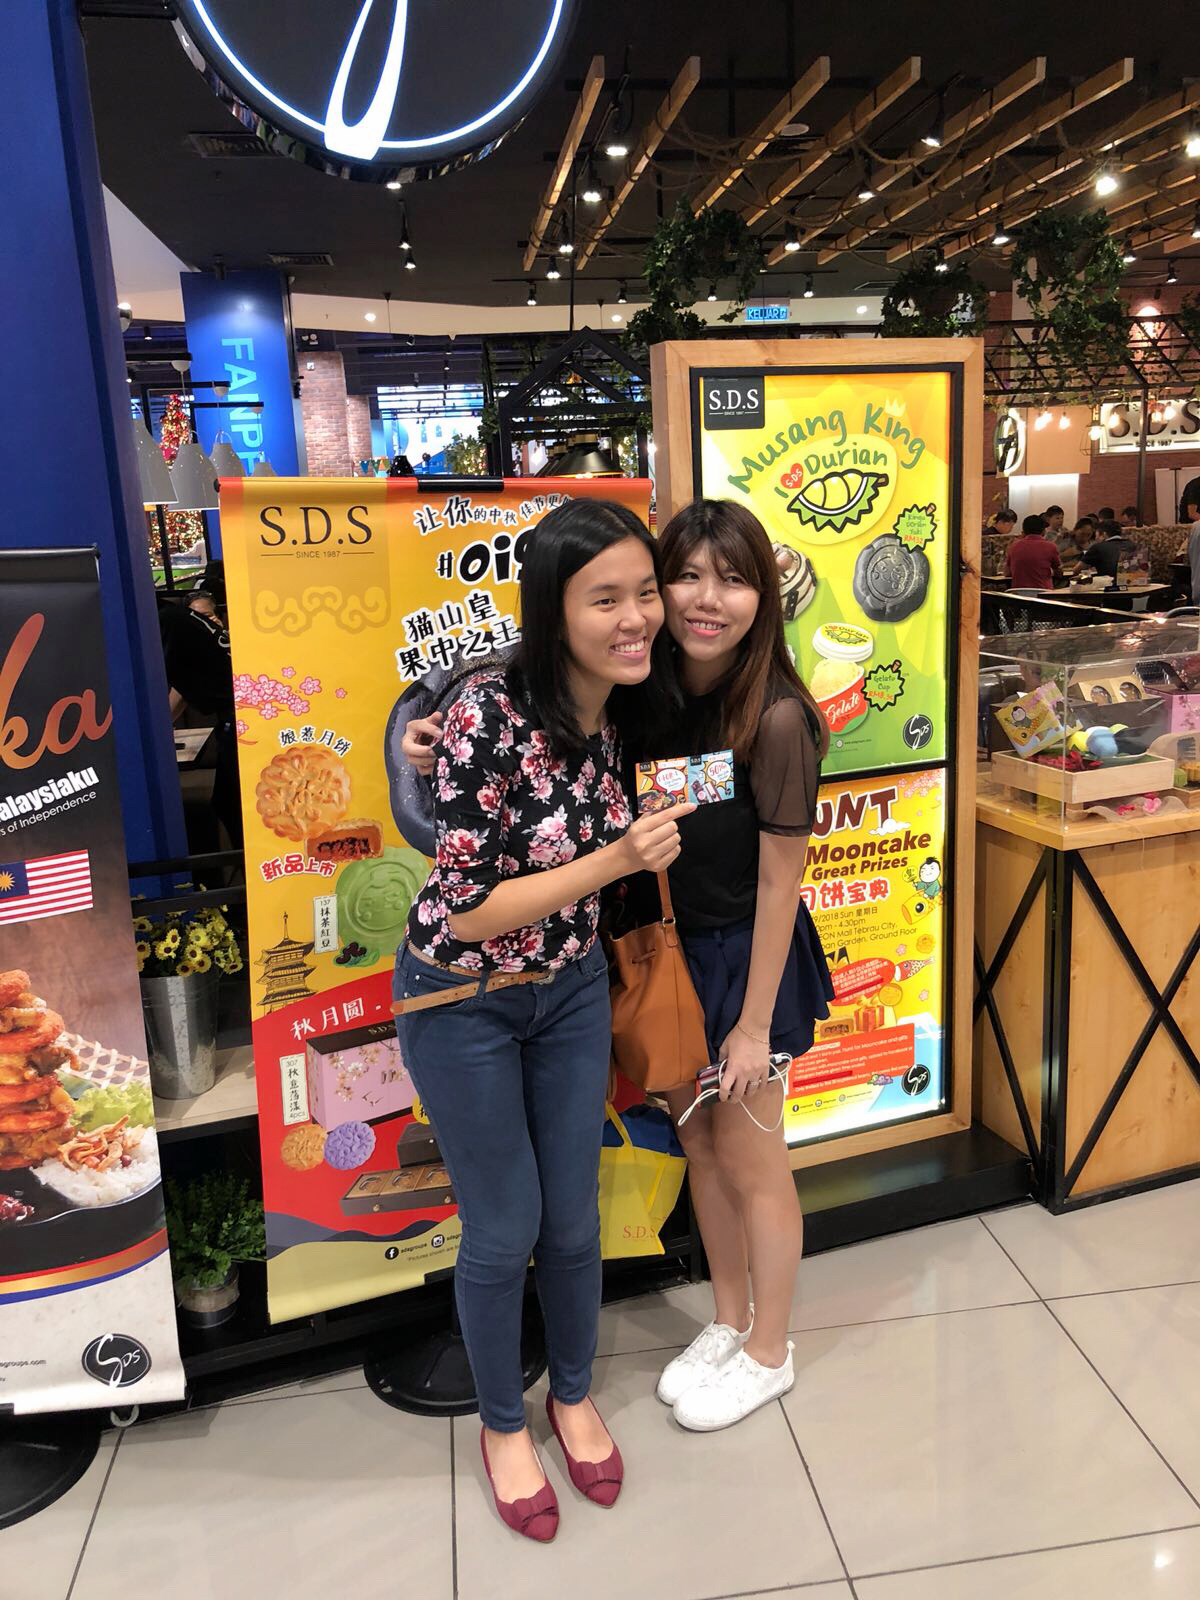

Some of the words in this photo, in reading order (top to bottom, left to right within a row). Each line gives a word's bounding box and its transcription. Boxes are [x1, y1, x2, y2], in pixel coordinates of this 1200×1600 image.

[748, 308, 778, 319] KELUAR
[709, 389, 759, 410] S.D.S
[727, 410, 847, 493] Musang
[864, 403, 926, 469] King
[804, 442, 887, 475] Durian
[260, 506, 372, 546] S.D.S
[296, 551, 320, 559] SINCE
[323, 550, 341, 558] 1987
[407, 594, 497, 643] 猫山皇
[399, 618, 520, 677] 果中之王
[0, 612, 112, 769] ka
[874, 675, 895, 683] Gelato
[281, 727, 350, 756] 娘惹月饼
[0, 766, 100, 821] alaysiaku
[7, 821, 18, 833] of
[20, 791, 96, 828] Independence
[811, 788, 897, 835] UNT
[806, 830, 932, 866] Mooncake
[262, 854, 335, 880] 新品上市
[812, 863, 857, 881] Great
[860, 856, 908, 874] Prizes
[813, 912, 839, 924] 9/2018
[840, 911, 854, 919] Sun
[816, 924, 833, 933] 0pm
[870, 930, 898, 941] Ground
[900, 928, 917, 936] Floor
